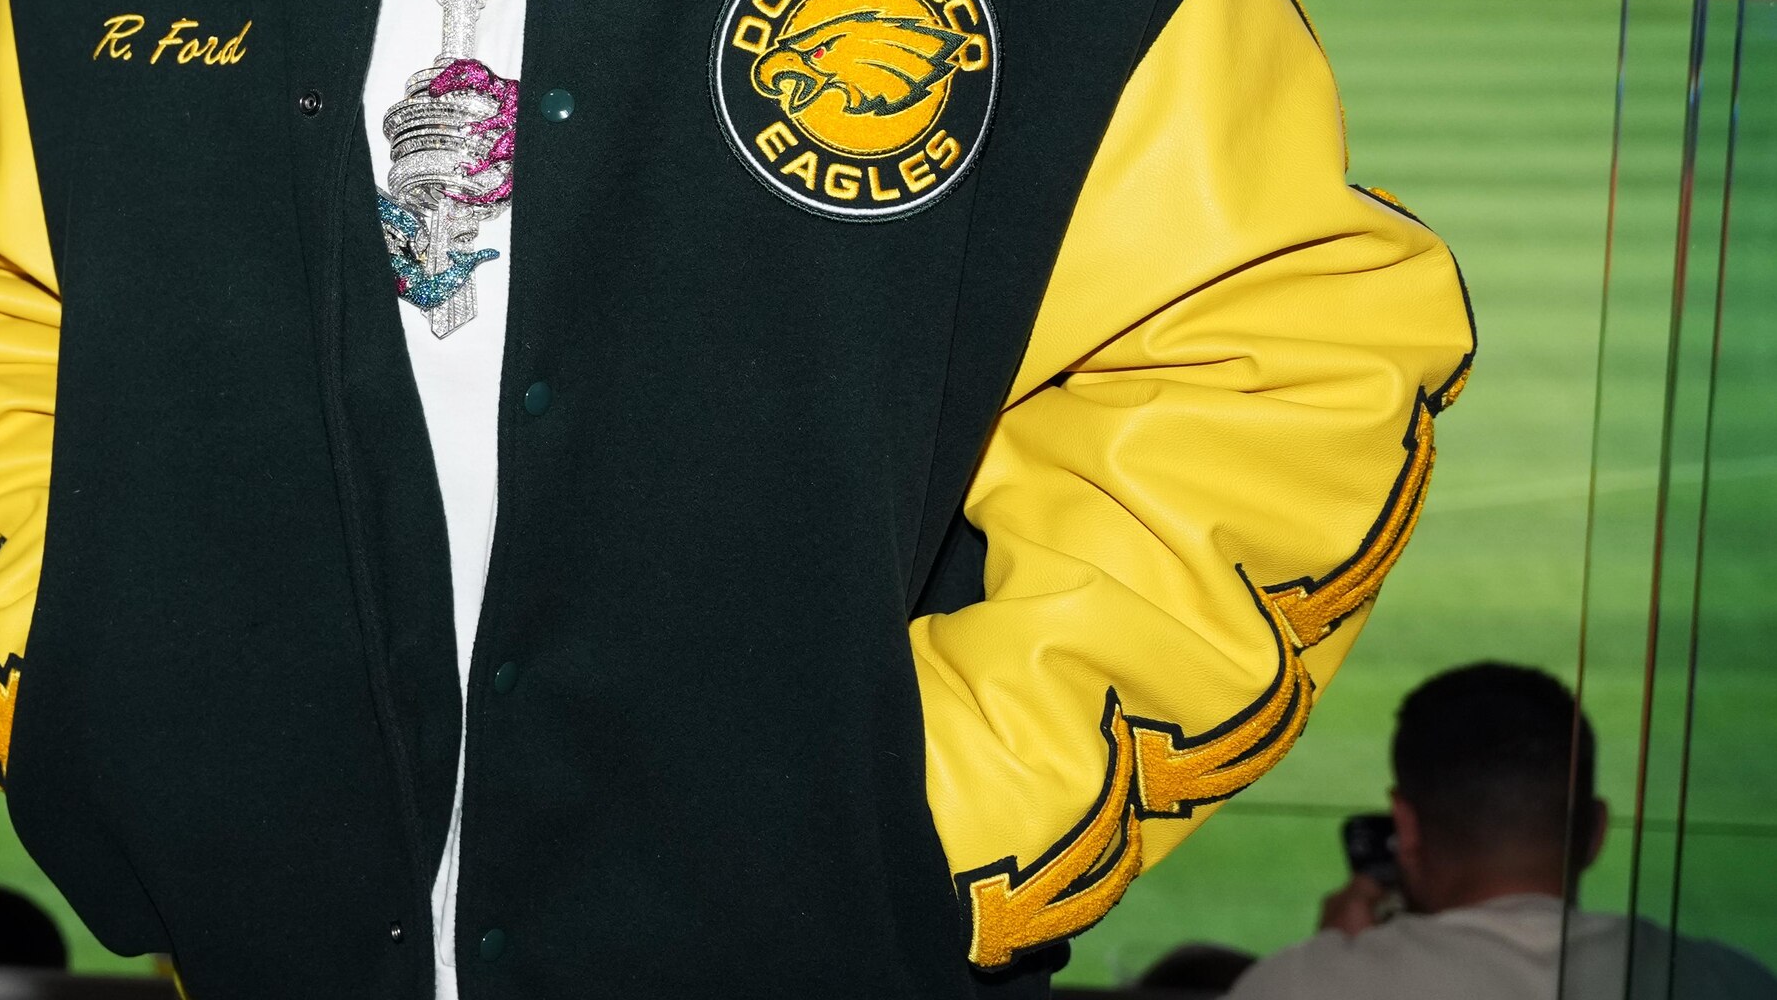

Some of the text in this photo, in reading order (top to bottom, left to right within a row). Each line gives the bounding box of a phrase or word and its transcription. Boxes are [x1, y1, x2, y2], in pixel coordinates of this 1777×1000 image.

[93, 14, 252, 65] R. Ford
[755, 121, 962, 201] EAGLES
